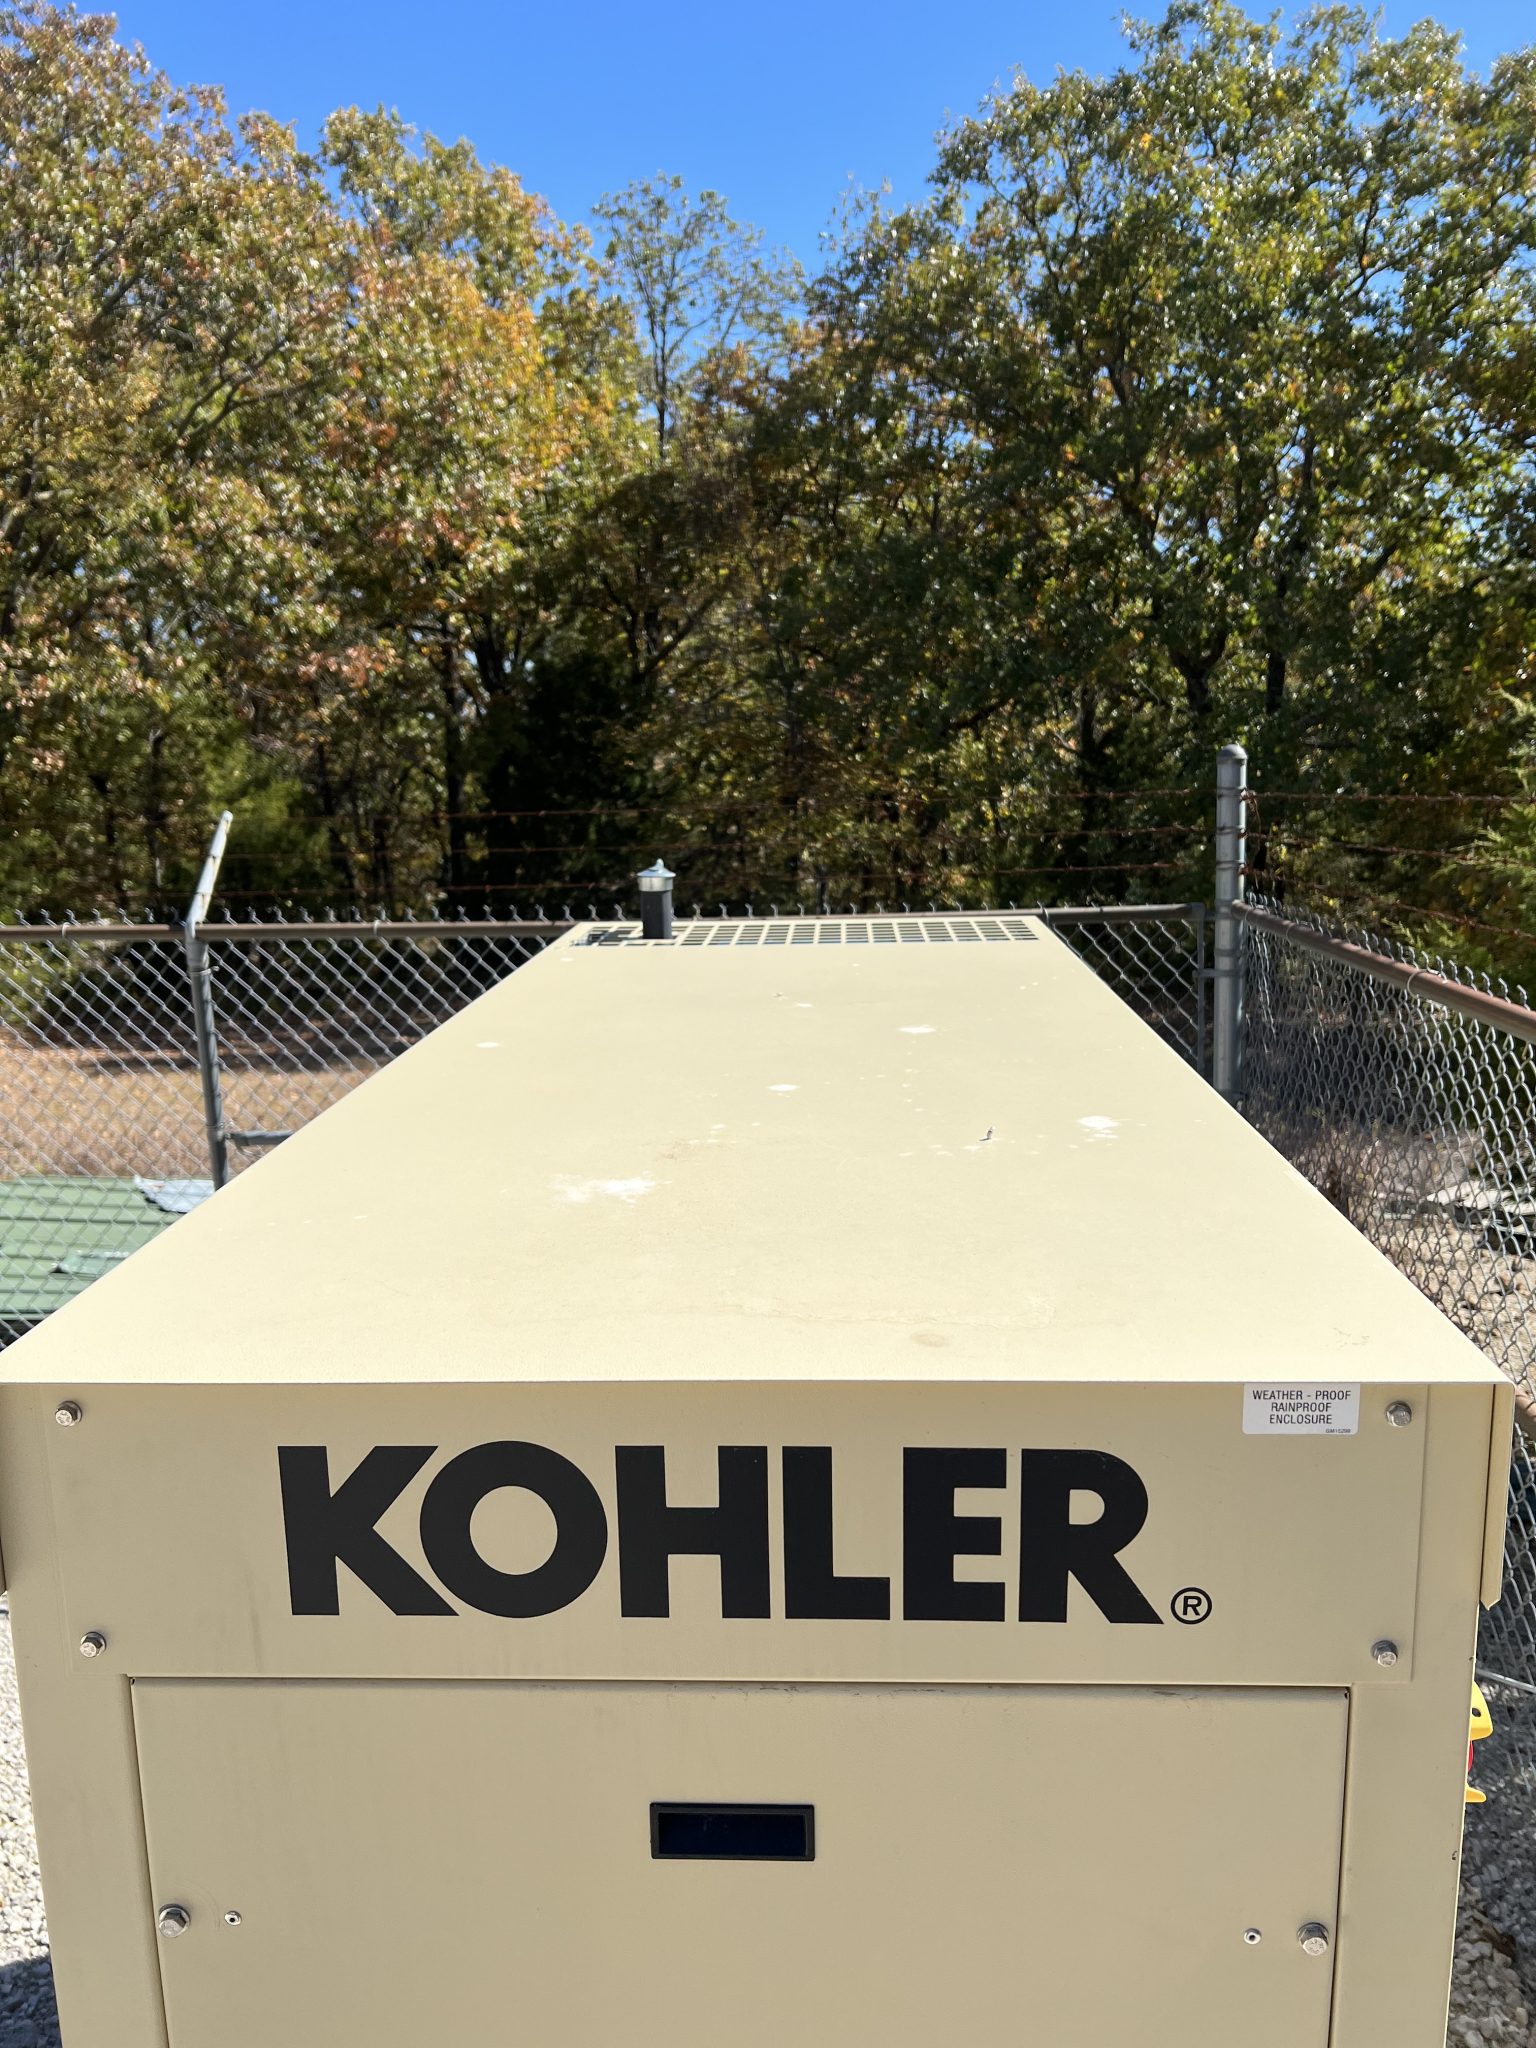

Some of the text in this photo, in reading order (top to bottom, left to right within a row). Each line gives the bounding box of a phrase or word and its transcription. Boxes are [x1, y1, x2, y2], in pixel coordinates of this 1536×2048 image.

[1252, 1389, 1303, 1401] WEATHER
[1315, 1389, 1352, 1401] PROOF
[1271, 1402, 1332, 1412] RAINPROOF
[1269, 1414, 1333, 1425] ENCLOSURE
